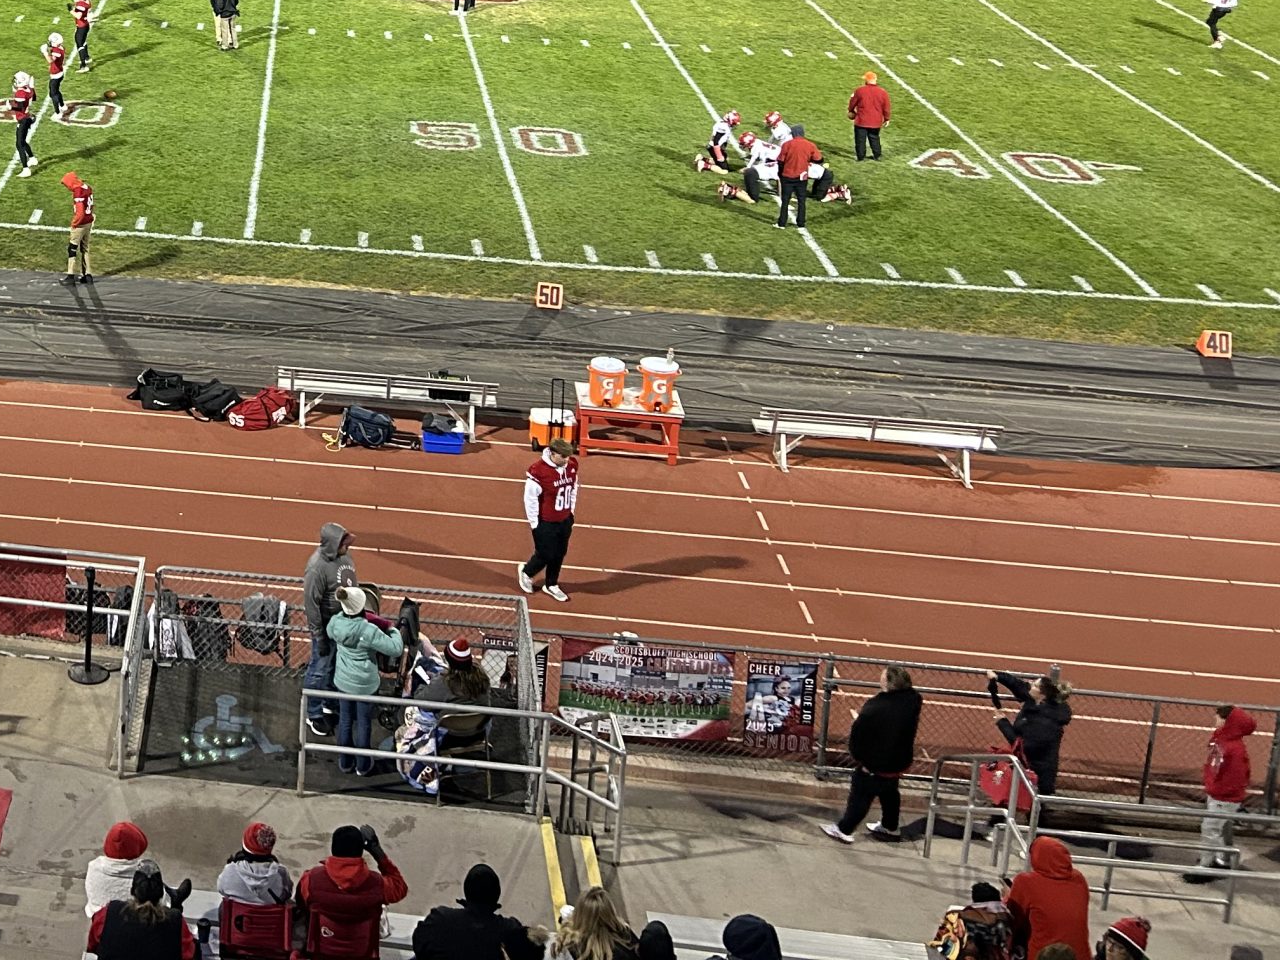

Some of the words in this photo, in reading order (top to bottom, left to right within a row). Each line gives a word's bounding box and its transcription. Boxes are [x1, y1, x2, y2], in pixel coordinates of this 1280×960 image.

[409, 120, 589, 157] 50
[908, 148, 1105, 185] 40
[538, 284, 560, 306] 50
[1206, 332, 1229, 354] 40
[602, 378, 615, 390] G
[652, 379, 667, 394] G
[554, 485, 572, 511] 60
[589, 650, 644, 668] 2024-2025
[614, 645, 666, 657] SCOTTSBLUFF
[667, 649, 687, 659] HIGH
[688, 651, 718, 661] SCHOOL
[749, 663, 781, 676] CHEER
[803, 678, 814, 707] CHLOE
[745, 719, 775, 732] 2025
[743, 731, 811, 752] SENIOR
